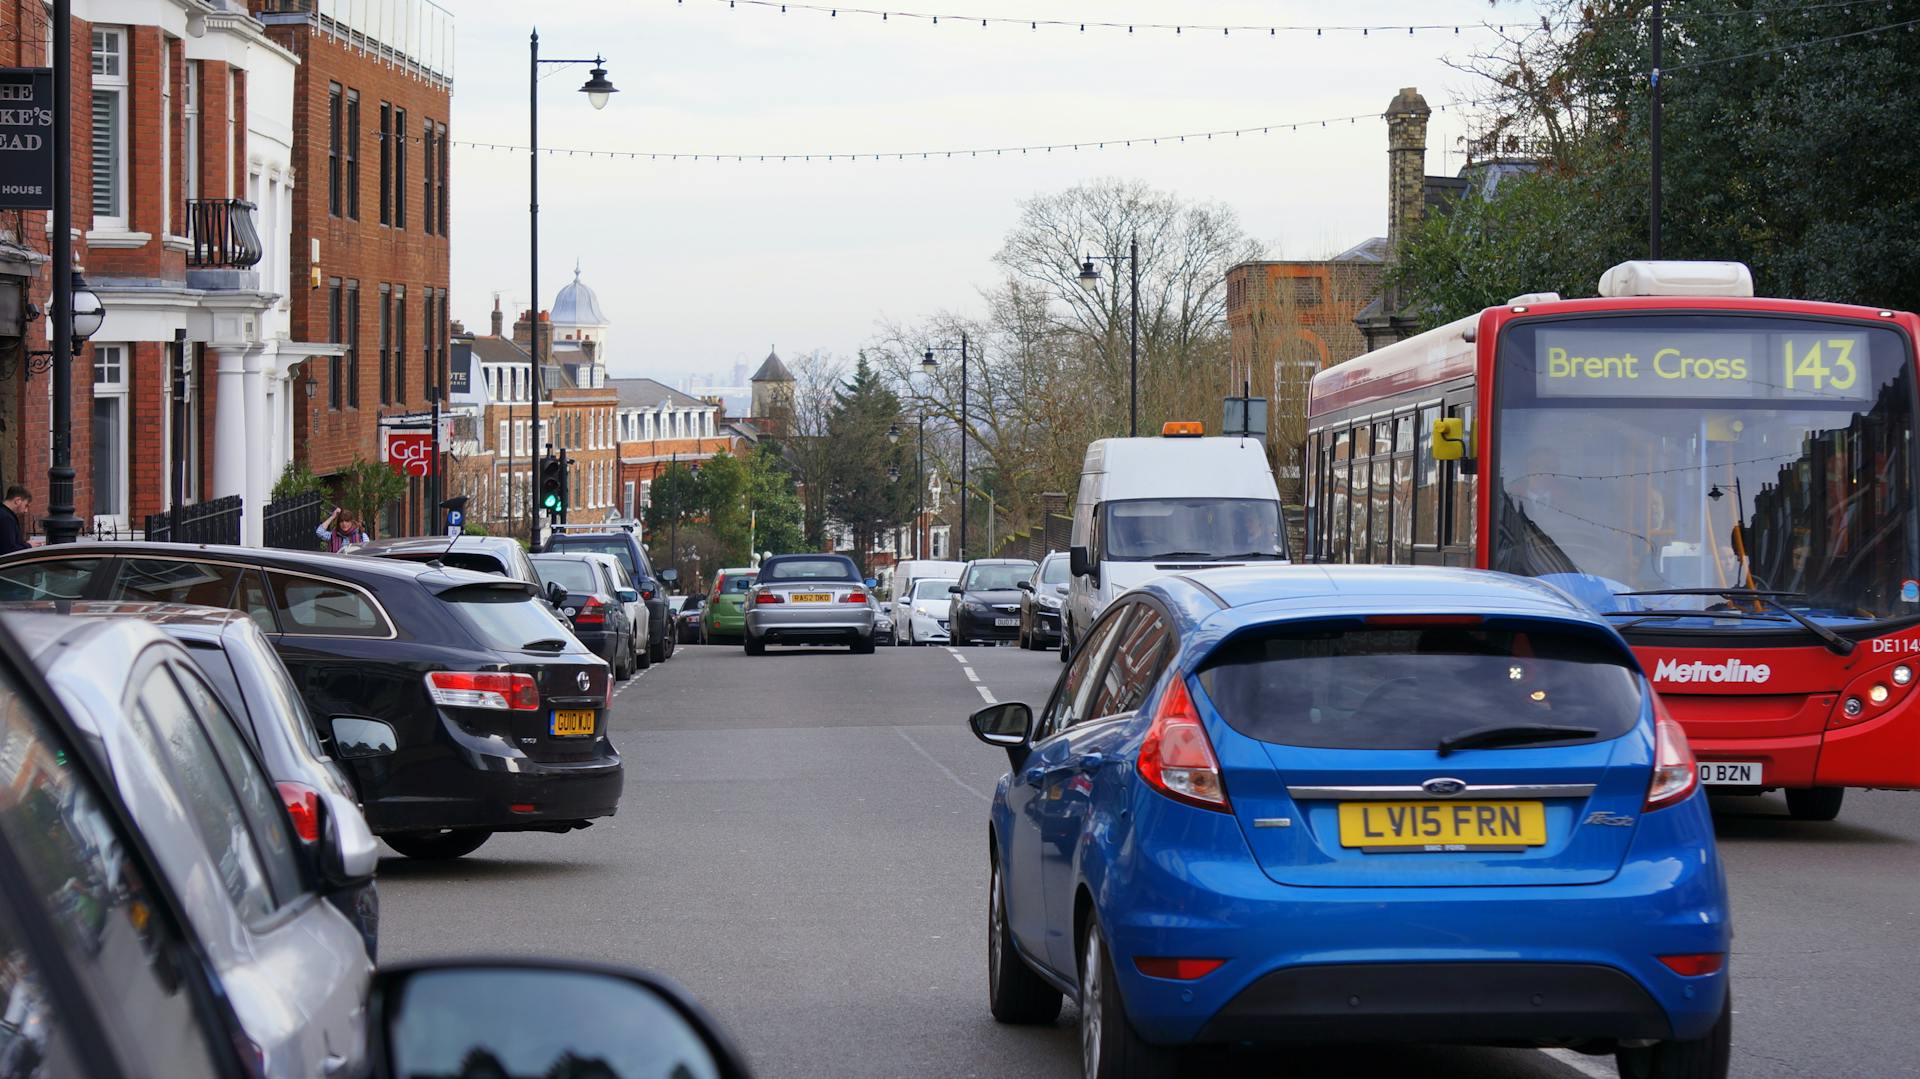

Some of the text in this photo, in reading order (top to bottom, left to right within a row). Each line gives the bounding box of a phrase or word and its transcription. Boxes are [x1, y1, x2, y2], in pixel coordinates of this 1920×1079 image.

[2, 185, 42, 195] HOUSE
[1549, 338, 1857, 390] Brent Cross 143
[451, 511, 461, 524] P
[1872, 639, 1920, 653] DE114
[1653, 658, 1771, 684] Metroline
[1716, 765, 1751, 782] BZN
[1362, 805, 1522, 838] LV15 FRN
